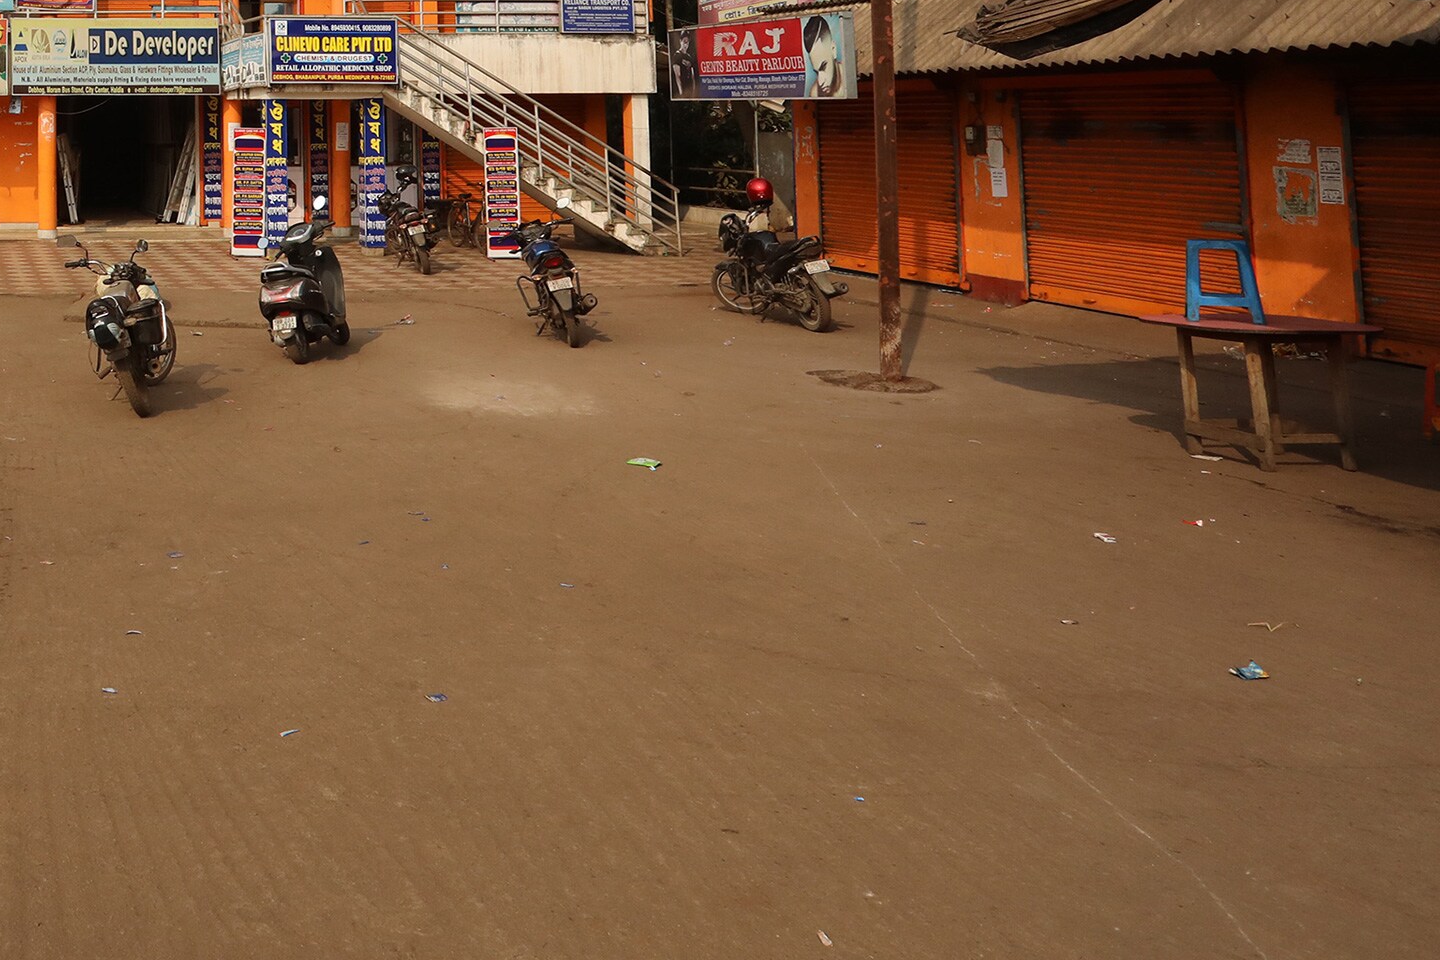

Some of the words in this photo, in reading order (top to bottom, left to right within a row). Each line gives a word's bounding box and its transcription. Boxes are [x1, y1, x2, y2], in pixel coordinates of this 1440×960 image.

[304, 24, 321, 32] Mobile
[105, 30, 128, 56] De
[132, 30, 214, 61] Developer
[276, 36, 320, 52] CLINEVO
[321, 36, 350, 52] CARE
[351, 36, 372, 52] PVT
[373, 36, 392, 52] LTD
[713, 27, 786, 56] RAJ
[275, 64, 299, 72] RETAIL
[300, 64, 341, 72] ALLOPATHIC
[341, 64, 374, 72] MEDICINE
[375, 64, 392, 72] SHOP
[700, 60, 725, 73] GENTS
[725, 58, 760, 72] BEAUTY
[762, 55, 805, 71] PARLOUR
[85, 86, 93, 94] City
